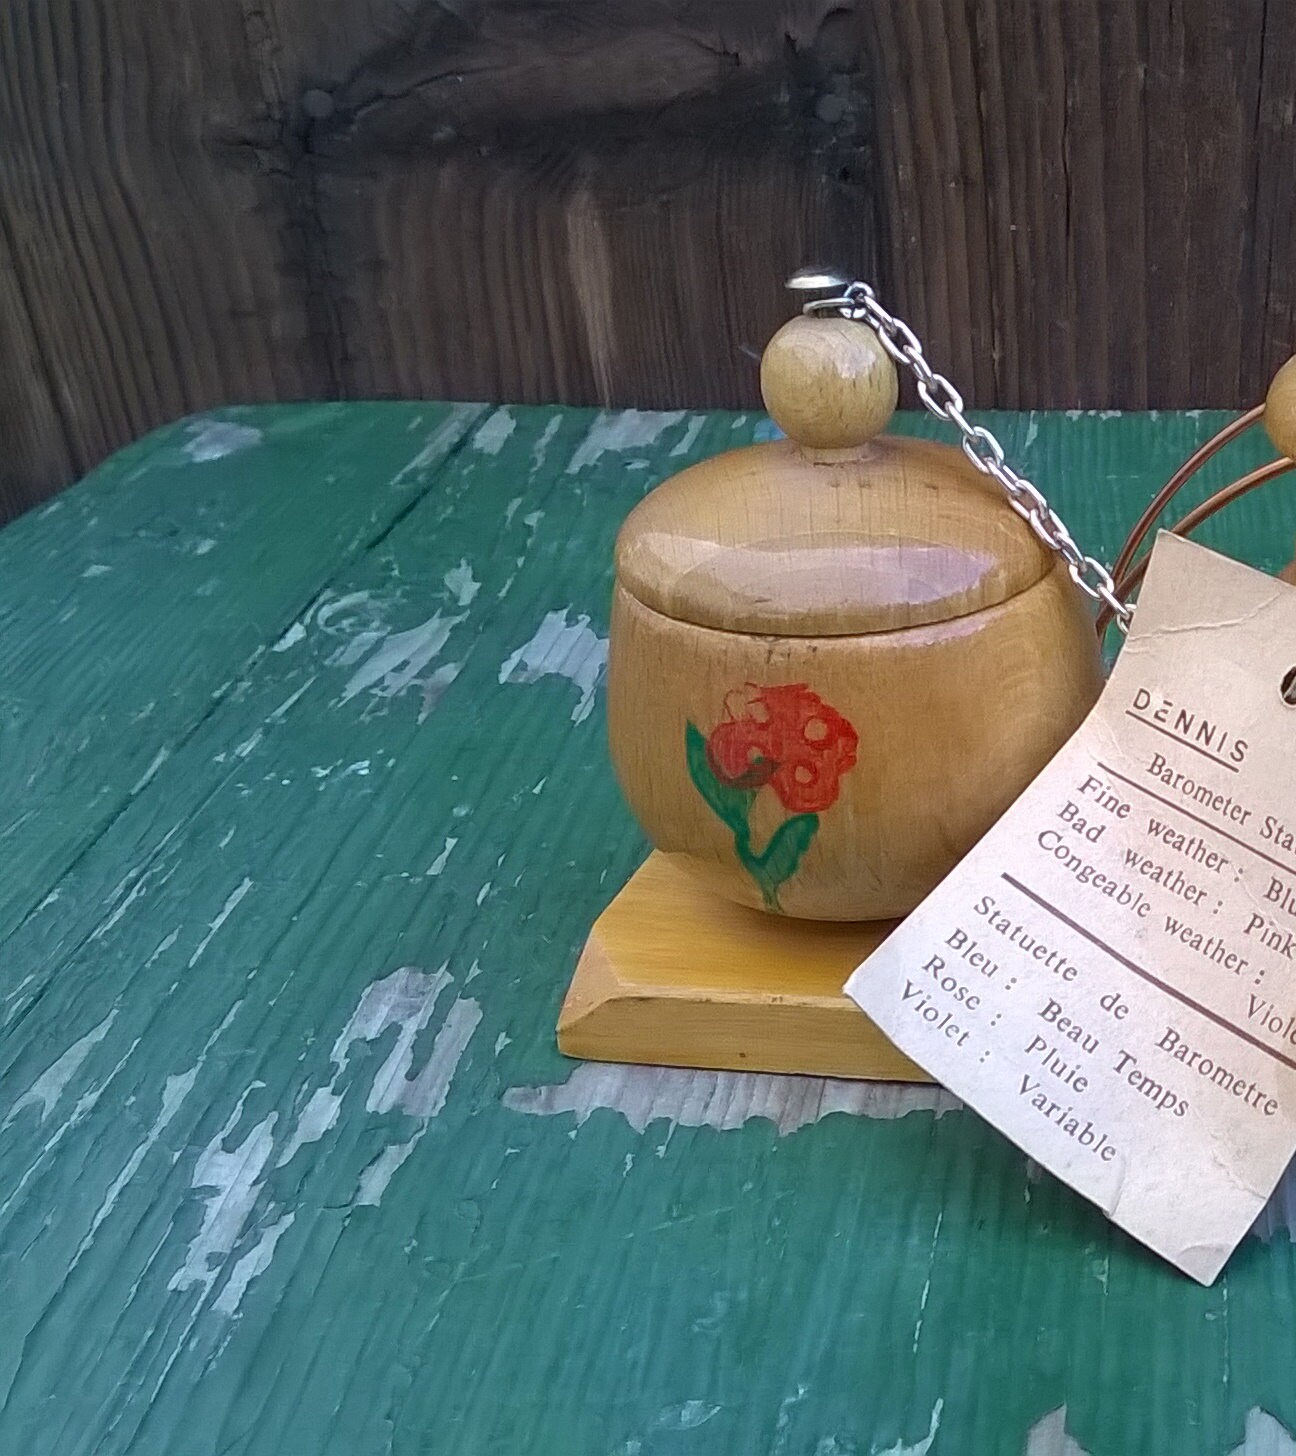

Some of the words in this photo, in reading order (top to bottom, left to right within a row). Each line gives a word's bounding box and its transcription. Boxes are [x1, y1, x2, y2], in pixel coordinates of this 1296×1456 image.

[1133, 688, 1248, 762] DENNIS
[1057, 801, 1106, 843] Bad
[1077, 775, 1131, 818] Fine
[1146, 753, 1252, 826] Barometer
[1038, 830, 1150, 917] Congeable
[973, 896, 1078, 981] Statuette
[1100, 993, 1129, 1020] de
[1155, 1026, 1278, 1116] Barometre
[1025, 1035, 1088, 1093] Pluie
[1038, 998, 1099, 1054] Beau
[1113, 1050, 1189, 1117] Temps
[1020, 1074, 1116, 1162] Variable
